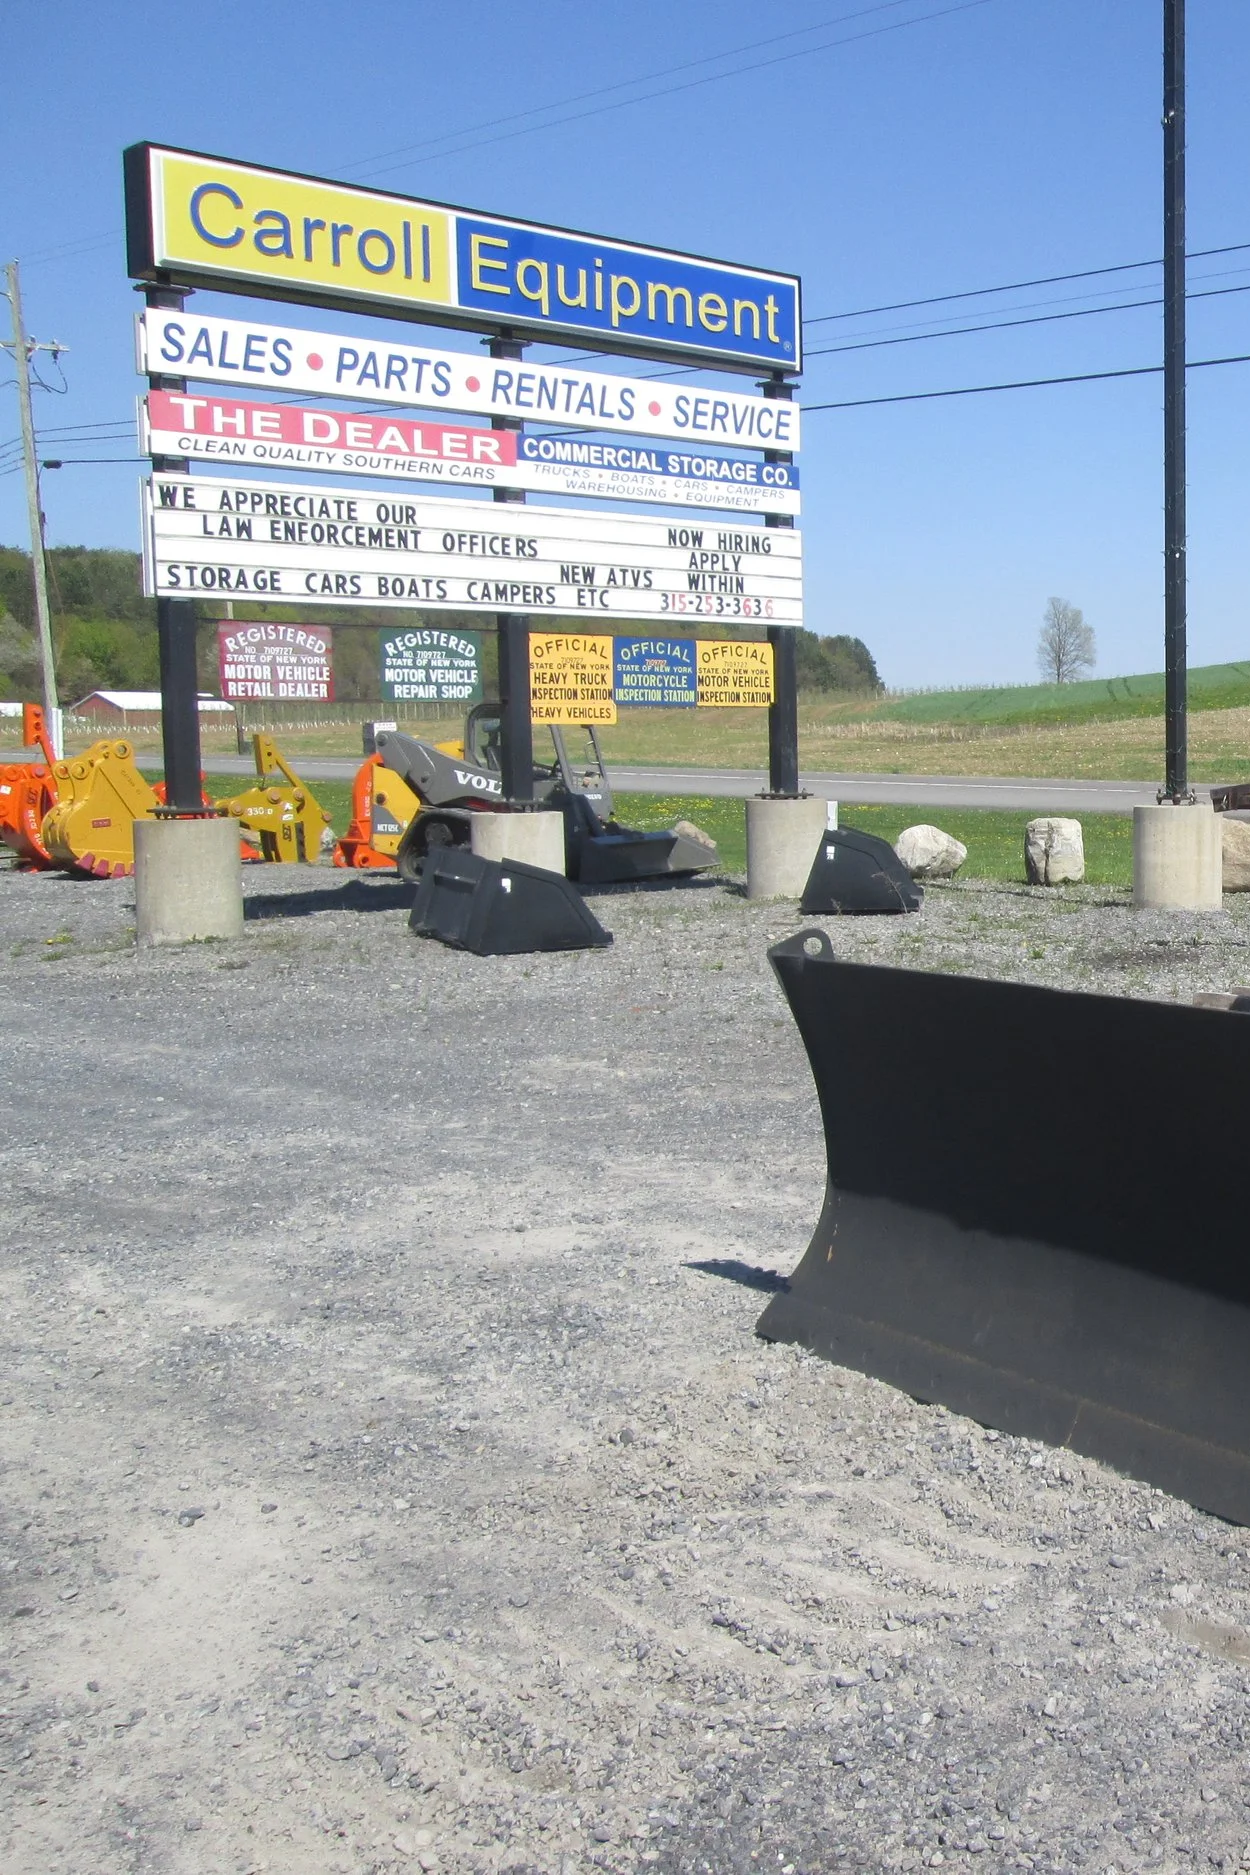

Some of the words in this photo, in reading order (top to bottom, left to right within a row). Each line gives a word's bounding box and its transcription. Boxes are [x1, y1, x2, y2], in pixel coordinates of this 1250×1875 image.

[189, 182, 431, 283] Carroll
[470, 233, 780, 344] Equipment
[160, 322, 293, 376] SALES
[335, 347, 452, 397] PARTS
[491, 369, 636, 421] RENTALS
[673, 395, 792, 441] SERVICE
[169, 397, 283, 440] THE
[303, 412, 503, 462] DEALER
[177, 436, 245, 456] CLEAN
[253, 444, 336, 465] QUALITY
[343, 453, 443, 475] SOUTHERN
[449, 463, 496, 480] CARS
[523, 437, 662, 472] COMMERCIAL
[668, 455, 757, 482] STORAGE
[762, 466, 792, 486] CO.
[533, 463, 590, 479] TRUCKS
[611, 472, 655, 486] BOATS
[674, 479, 708, 492] CARS
[726, 485, 785, 499] CAMPERS
[566, 480, 667, 498] WAREHOUSING
[686, 492, 759, 507] EQUIPMENT
[158, 484, 196, 509] WE
[219, 490, 358, 521] APPRECIATE
[376, 503, 418, 525] OUR
[202, 515, 252, 541] LAW
[270, 520, 423, 550] ENFORCEMENT
[442, 532, 538, 558] OFFICERS
[667, 528, 704, 548] NOW
[718, 532, 772, 554] HIRING
[689, 552, 742, 573] APPLY
[167, 564, 283, 592] STORAGE
[305, 572, 362, 595] CARS
[378, 576, 448, 600] BOATS
[466, 581, 556, 605] CAMPERS
[577, 588, 610, 608] ETC
[560, 564, 596, 585] NEW
[607, 568, 653, 589] ATVS
[687, 573, 745, 594] WITHIN
[660, 593, 774, 617] 315-253-3636
[225, 625, 326, 654] REGISTERED
[385, 630, 476, 658] REGISTERED
[533, 639, 608, 660] OFFICIAL
[226, 654, 256, 663] STATE
[260, 655, 273, 663] OF
[276, 655, 297, 664] NEW
[300, 656, 327, 665] YORK
[385, 658, 413, 666] STATE
[431, 659, 450, 667] NEW
[452, 660, 476, 668] YORK
[621, 642, 690, 663] OFFICIAL
[702, 645, 767, 665] OFFICIAL
[224, 664, 271, 680] MOTOR
[276, 666, 330, 681] VEHICLE
[385, 668, 426, 682] MOTOR
[429, 669, 478, 683] VEHICLE
[530, 662, 554, 670] STATE
[617, 664, 640, 672] STATE
[642, 664, 653, 672] OF
[654, 665, 671, 673] NEW
[673, 666, 693, 674] YORK
[698, 667, 720, 675] STATE
[533, 672, 568, 685] HEAVY
[574, 672, 607, 685] TRUCK
[623, 674, 688, 688] MOTORCYCLE
[697, 675, 729, 687] MOTOR
[732, 676, 770, 688] VEHICLE
[227, 682, 274, 697] RETAIL
[279, 683, 328, 698] DEALER
[394, 684, 437, 699] REPAIR
[441, 685, 473, 699] SHOP
[531, 687, 578, 700] NSPECTION
[580, 688, 613, 701] STATION
[615, 688, 662, 701] INSPECTION
[663, 690, 695, 702] STATION
[696, 690, 741, 703] INSPECTION
[742, 691, 771, 703] STATION
[531, 706, 562, 718] HEAVY
[566, 707, 611, 719] VEHICLES
[454, 769, 502, 795] VOL
